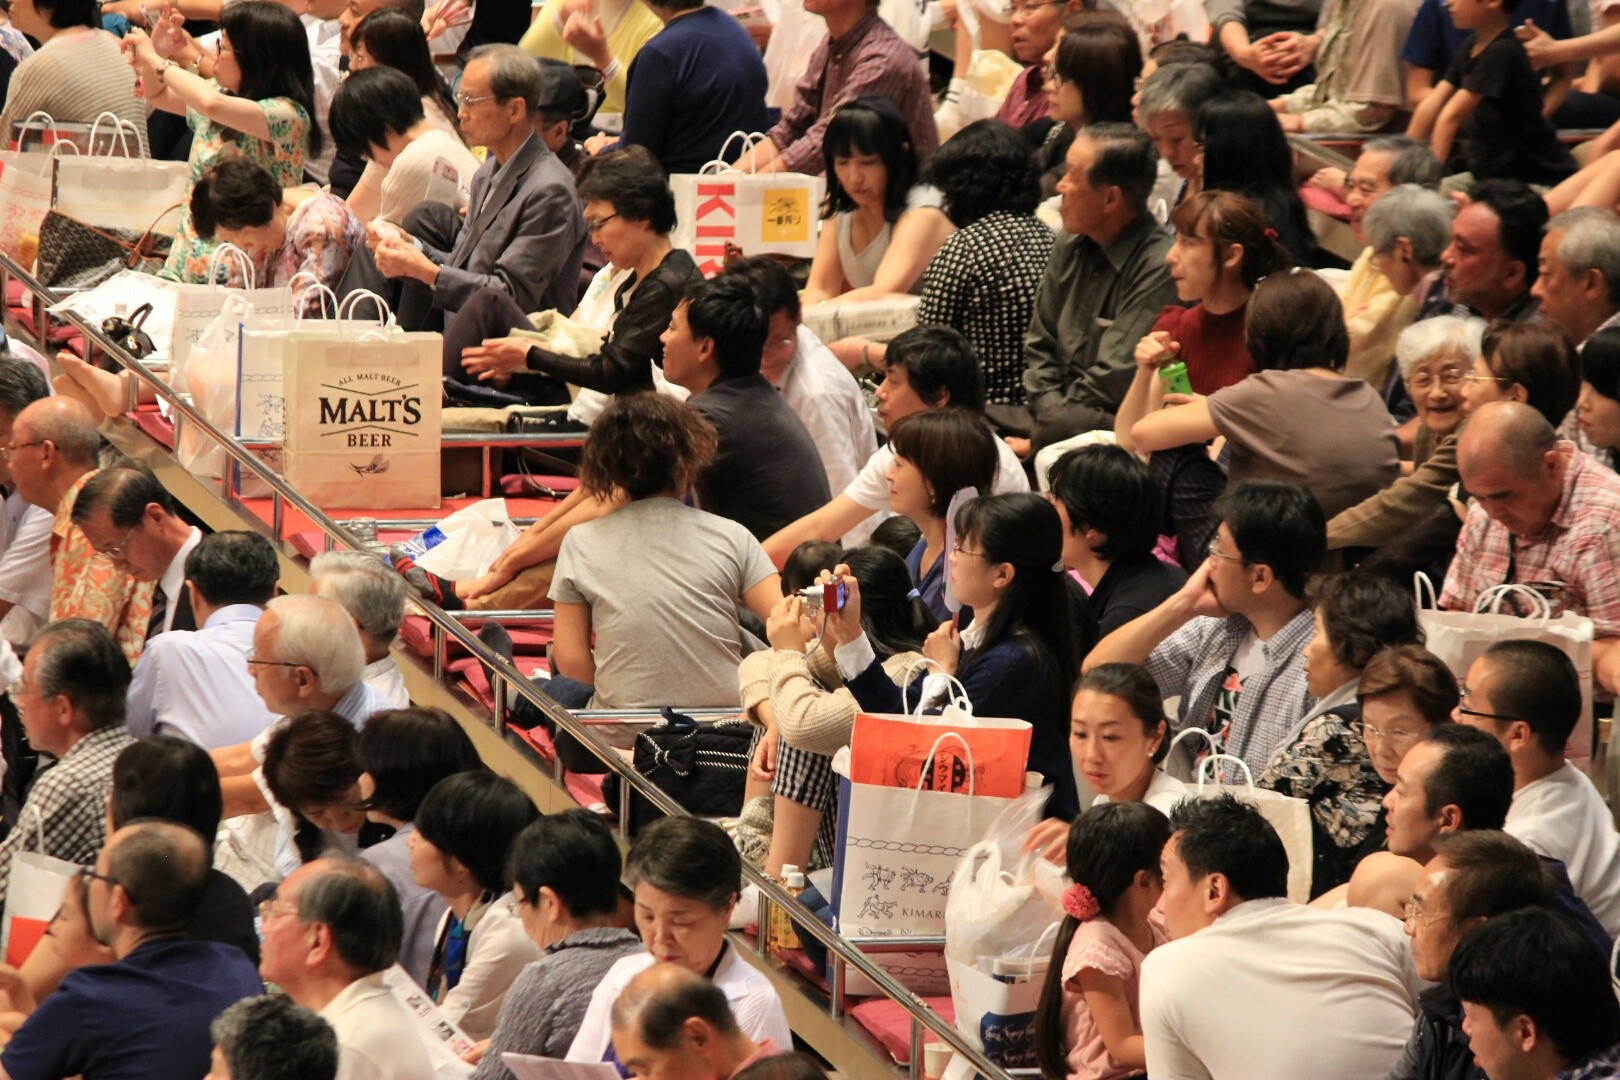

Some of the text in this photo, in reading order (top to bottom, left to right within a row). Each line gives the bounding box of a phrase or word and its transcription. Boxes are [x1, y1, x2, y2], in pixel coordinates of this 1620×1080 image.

[338, 373, 401, 386] ALL MALT BEER
[318, 394, 422, 425] MALT'S
[347, 433, 392, 447] BEER
[902, 908, 945, 919] KIMAR
